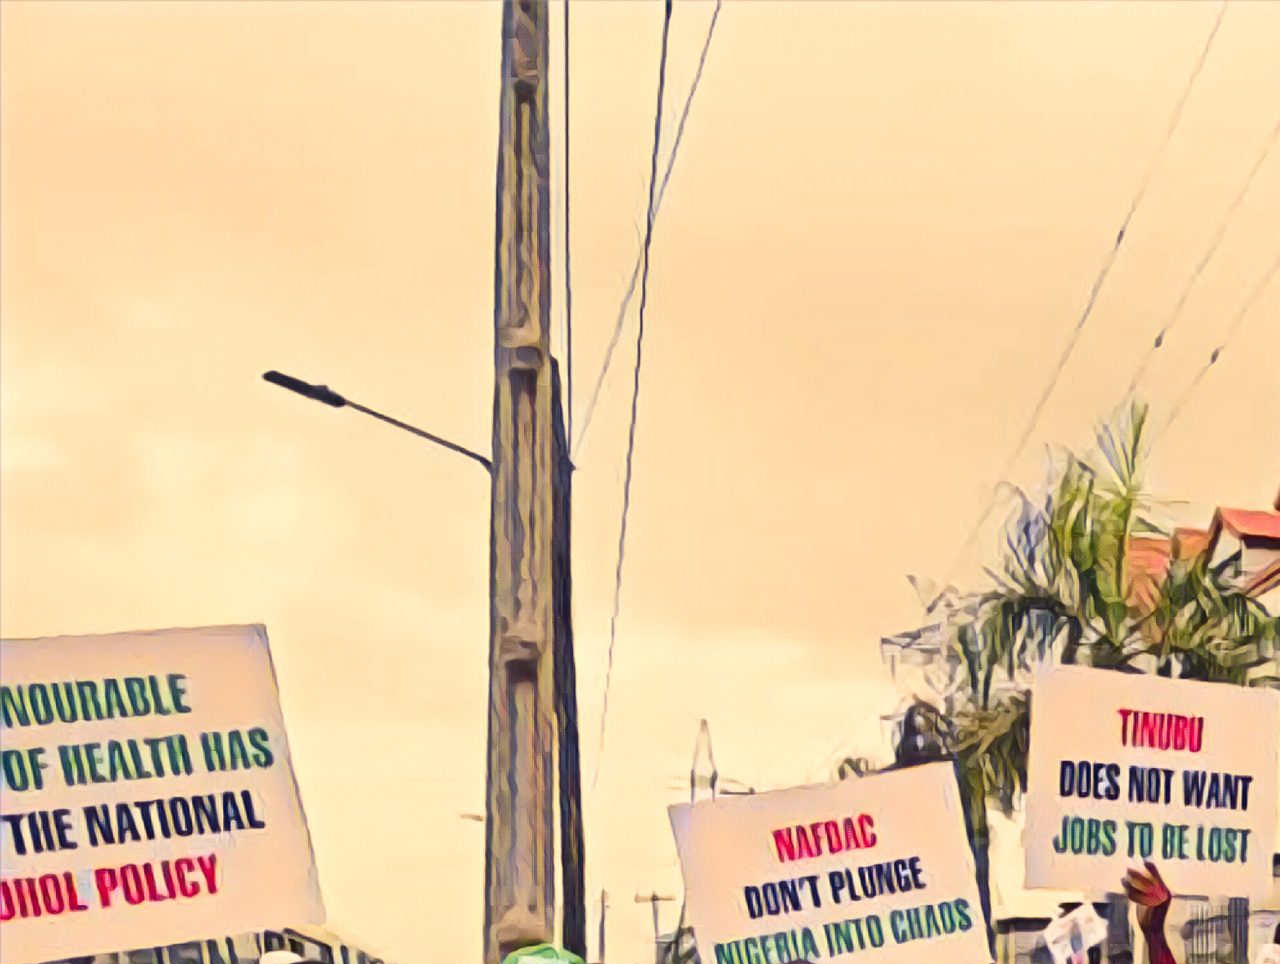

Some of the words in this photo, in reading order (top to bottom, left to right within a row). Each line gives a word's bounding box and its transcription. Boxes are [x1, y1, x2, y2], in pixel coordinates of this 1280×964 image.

[1116, 709, 1204, 753] TINUBU
[3, 747, 49, 791] OF
[58, 734, 193, 786] HEALTH
[201, 727, 274, 771] HAS
[1059, 760, 1121, 800] DOES
[1128, 765, 1175, 805] NOT
[1183, 770, 1254, 811] WANT
[1, 809, 77, 854] THE
[83, 790, 265, 847] NATIONAL
[772, 813, 878, 863] NAFDAC
[1052, 815, 1118, 856] JOBS
[1125, 821, 1154, 858] TO
[1162, 822, 1190, 860] BE
[1196, 824, 1252, 863] LOST
[94, 853, 218, 908] POLICY
[744, 875, 821, 919] DON'T
[828, 856, 926, 904] PLUNGE
[823, 915, 885, 958] INTO
[890, 898, 973, 944] CHAOS
